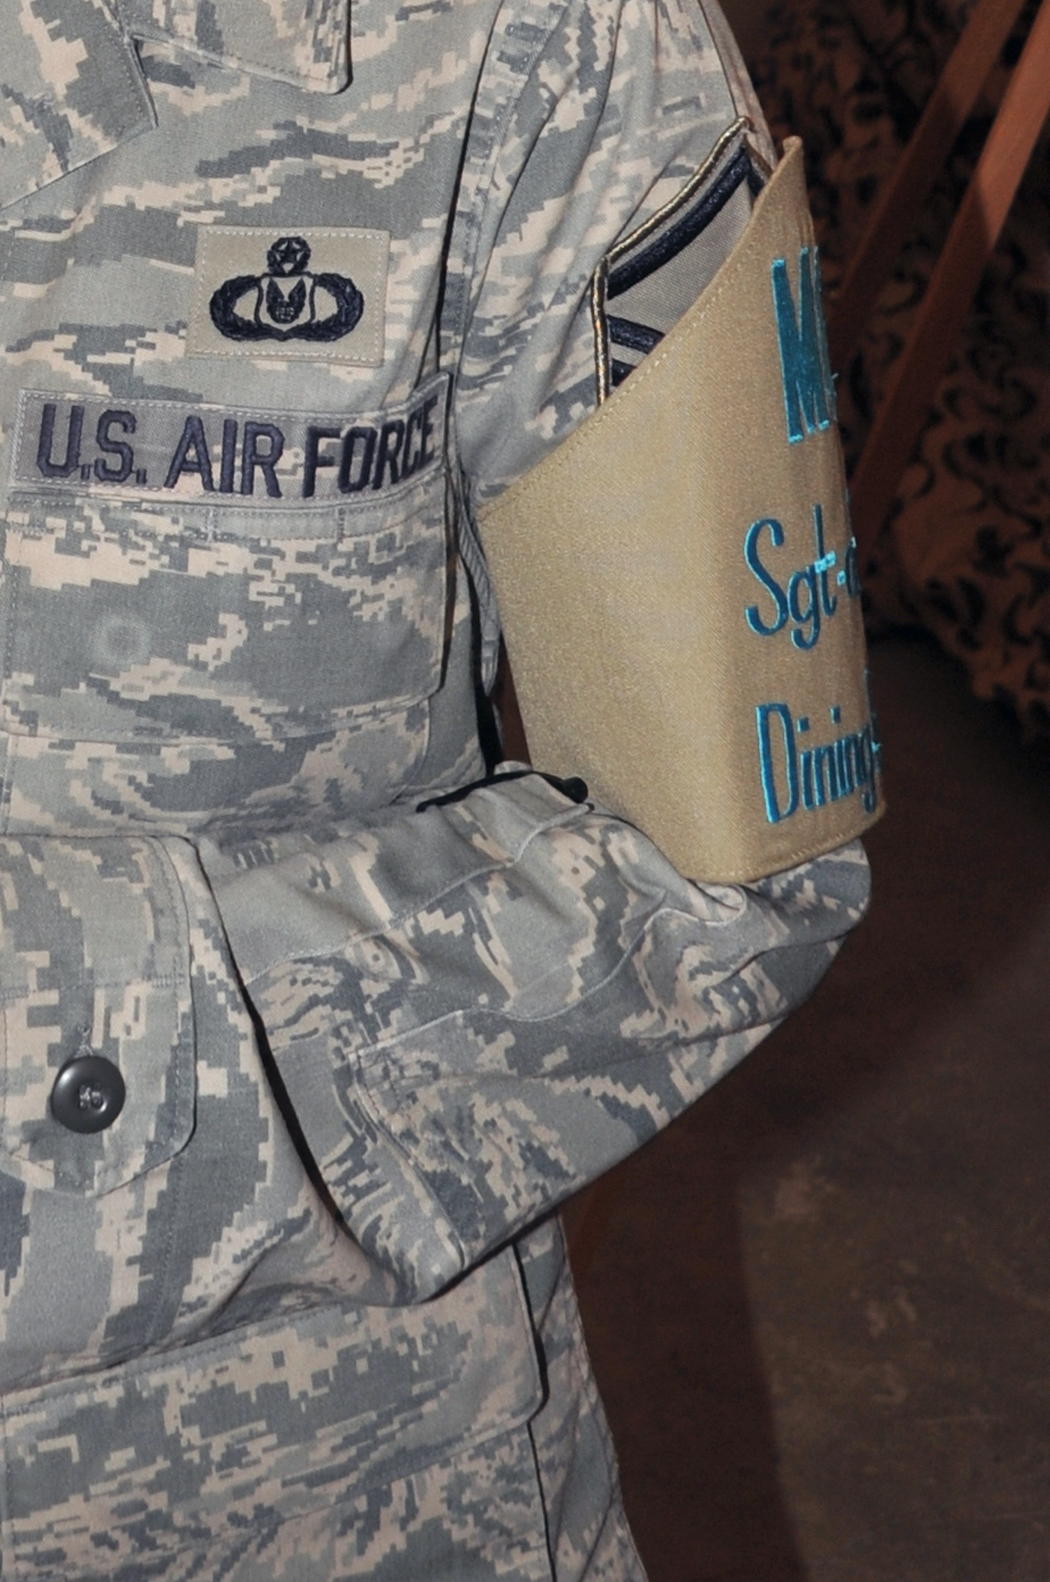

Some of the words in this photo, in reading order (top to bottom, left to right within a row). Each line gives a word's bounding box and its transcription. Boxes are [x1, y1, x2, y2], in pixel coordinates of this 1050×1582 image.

[772, 245, 836, 444] M
[36, 403, 147, 484] U.S.
[164, 415, 283, 498] AIR
[303, 396, 438, 498] FORCE
